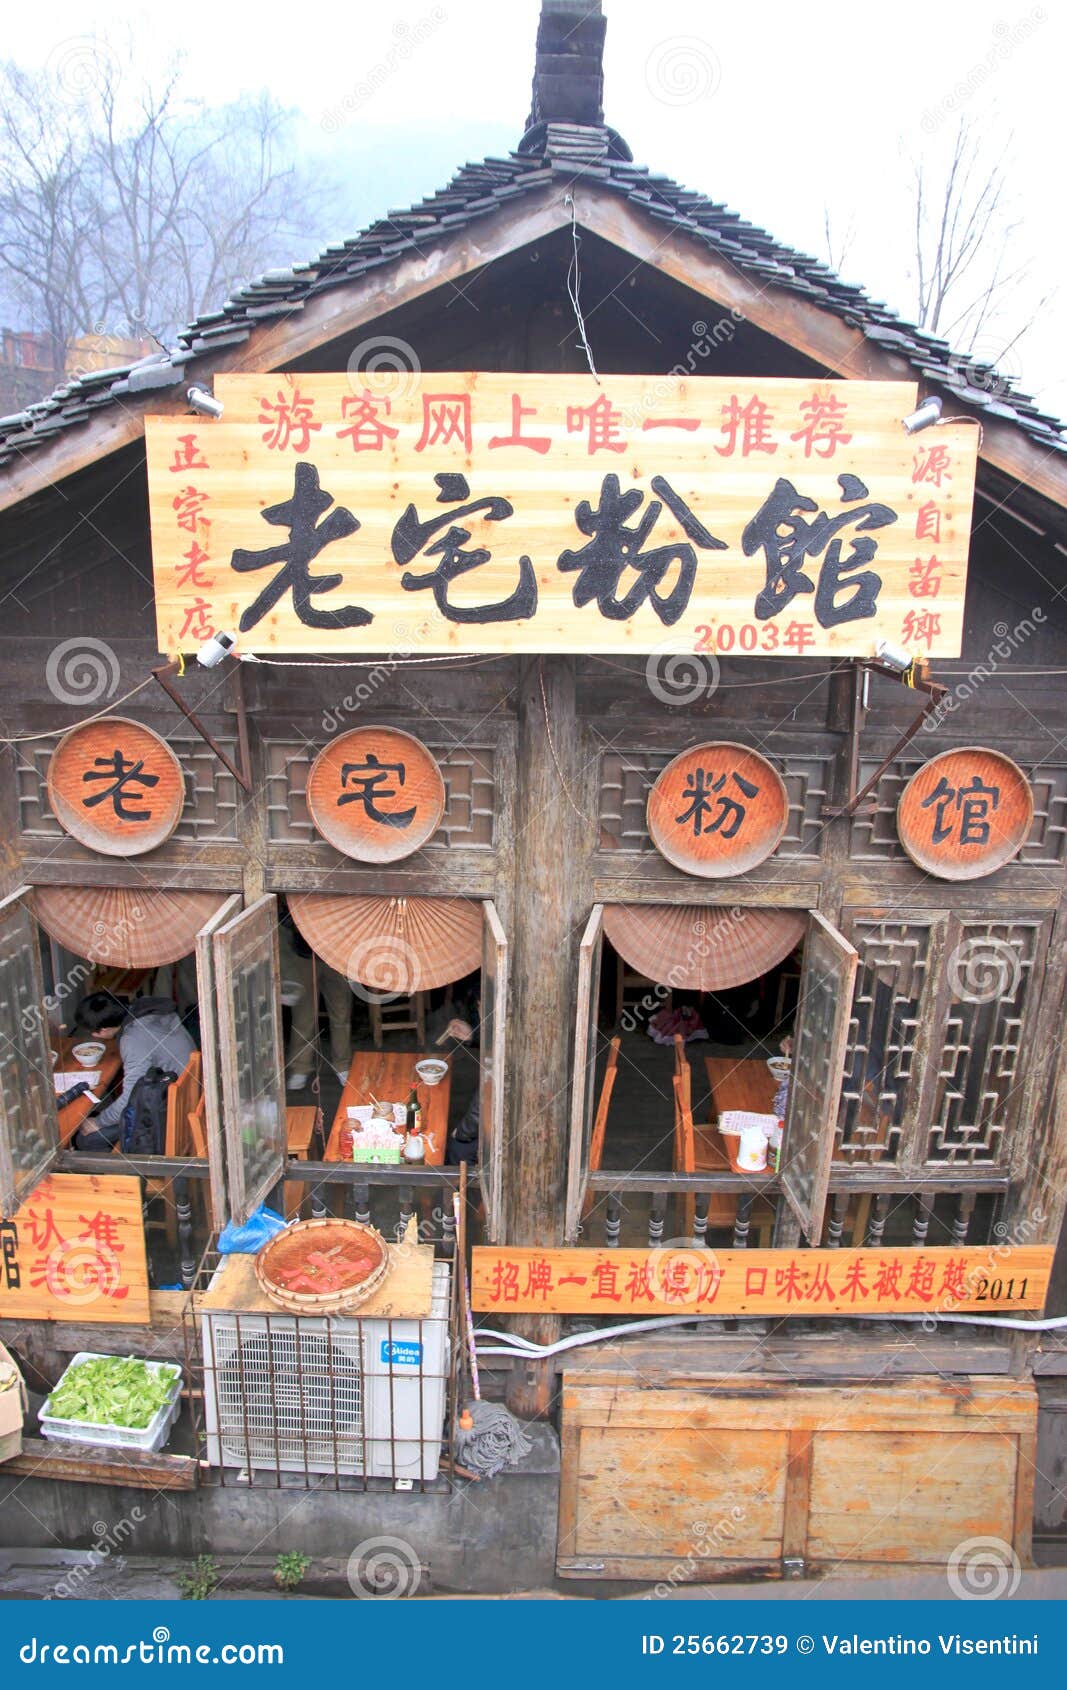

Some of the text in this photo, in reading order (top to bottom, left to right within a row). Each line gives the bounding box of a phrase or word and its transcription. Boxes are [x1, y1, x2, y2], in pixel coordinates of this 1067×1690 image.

[258, 388, 852, 459] 游客网上唯一推荐
[168, 434, 215, 641] 正宗老店
[231, 462, 898, 632] 老宅粉館
[693, 621, 816, 654] 2003年
[82, 749, 160, 822] 老
[338, 753, 418, 828] 宅
[675, 767, 760, 839] 粉
[921, 776, 1000, 847] 馆
[23, 1207, 126, 1253] 认准
[489, 1257, 1028, 1304] 招牌一直被模仿 口味从未被超越 2011
